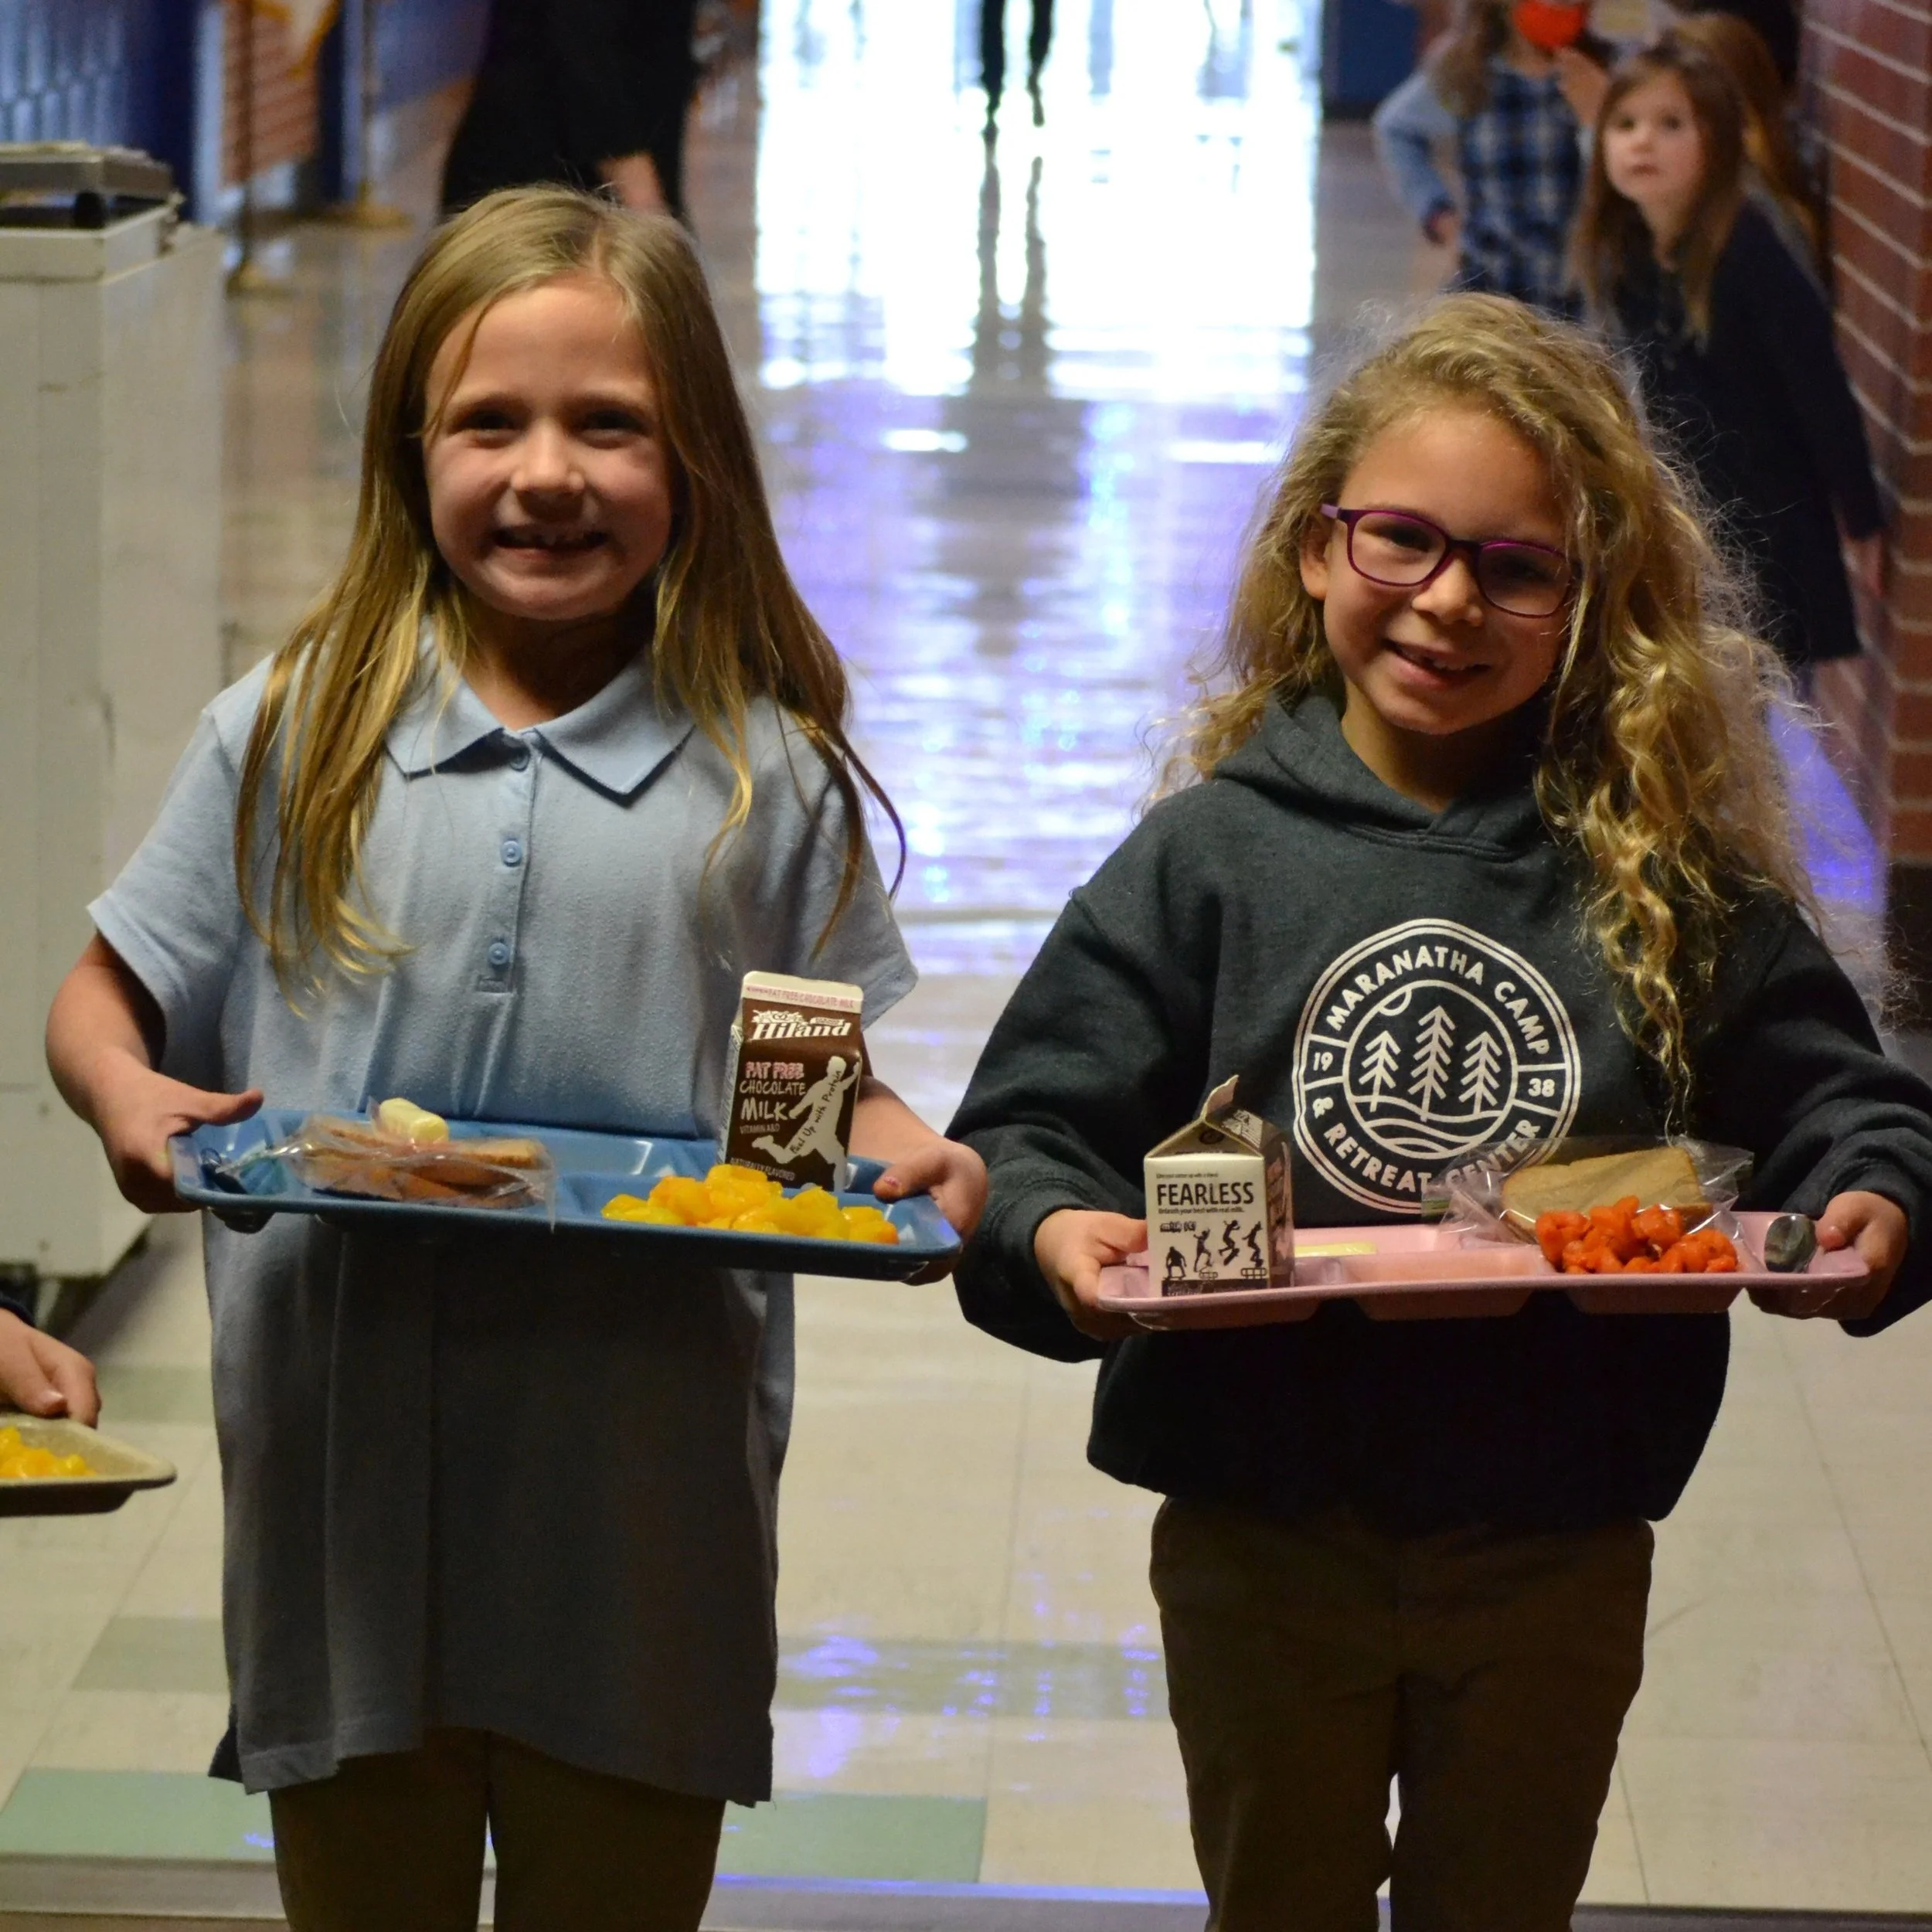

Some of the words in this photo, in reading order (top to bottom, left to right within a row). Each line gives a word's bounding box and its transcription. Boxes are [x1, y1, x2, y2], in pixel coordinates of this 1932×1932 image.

[1326, 945, 1484, 1031] MARANATHA
[1494, 981, 1549, 1055] CAMP
[751, 1022, 852, 1040] Hiland
[745, 1061, 771, 1079] FAT
[774, 1062, 804, 1080] FREE
[1313, 1052, 1334, 1071] 19
[739, 1080, 807, 1096] CHOCOLATE
[1528, 1078, 1556, 1097] 38
[740, 1097, 787, 1121] MILK
[802, 1126, 816, 1137] Up
[815, 1106, 826, 1123] with
[821, 1070, 841, 1102] Protein
[1312, 1097, 1334, 1119] &
[1323, 1122, 1431, 1193] RETREAT
[1157, 1182, 1254, 1206] FEARLESS
